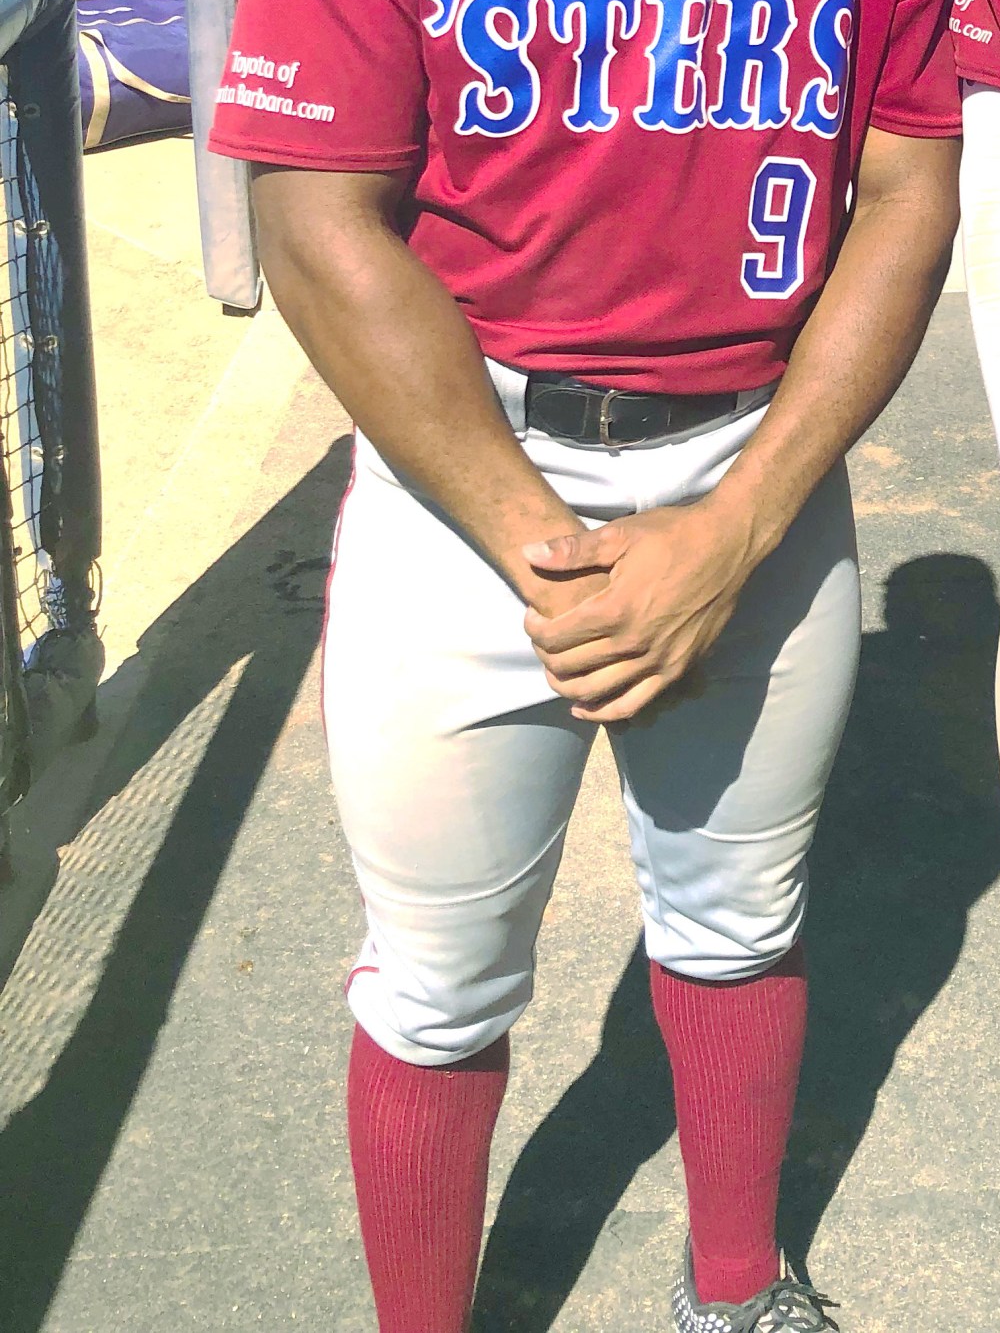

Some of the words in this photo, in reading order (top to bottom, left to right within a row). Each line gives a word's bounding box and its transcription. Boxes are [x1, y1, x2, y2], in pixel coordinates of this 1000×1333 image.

[948, 17, 993, 45] ra.com
[231, 50, 275, 78] Toyota
[277, 61, 301, 88] of
[236, 83, 335, 123] Barbara.com
[740, 156, 817, 300] 9
